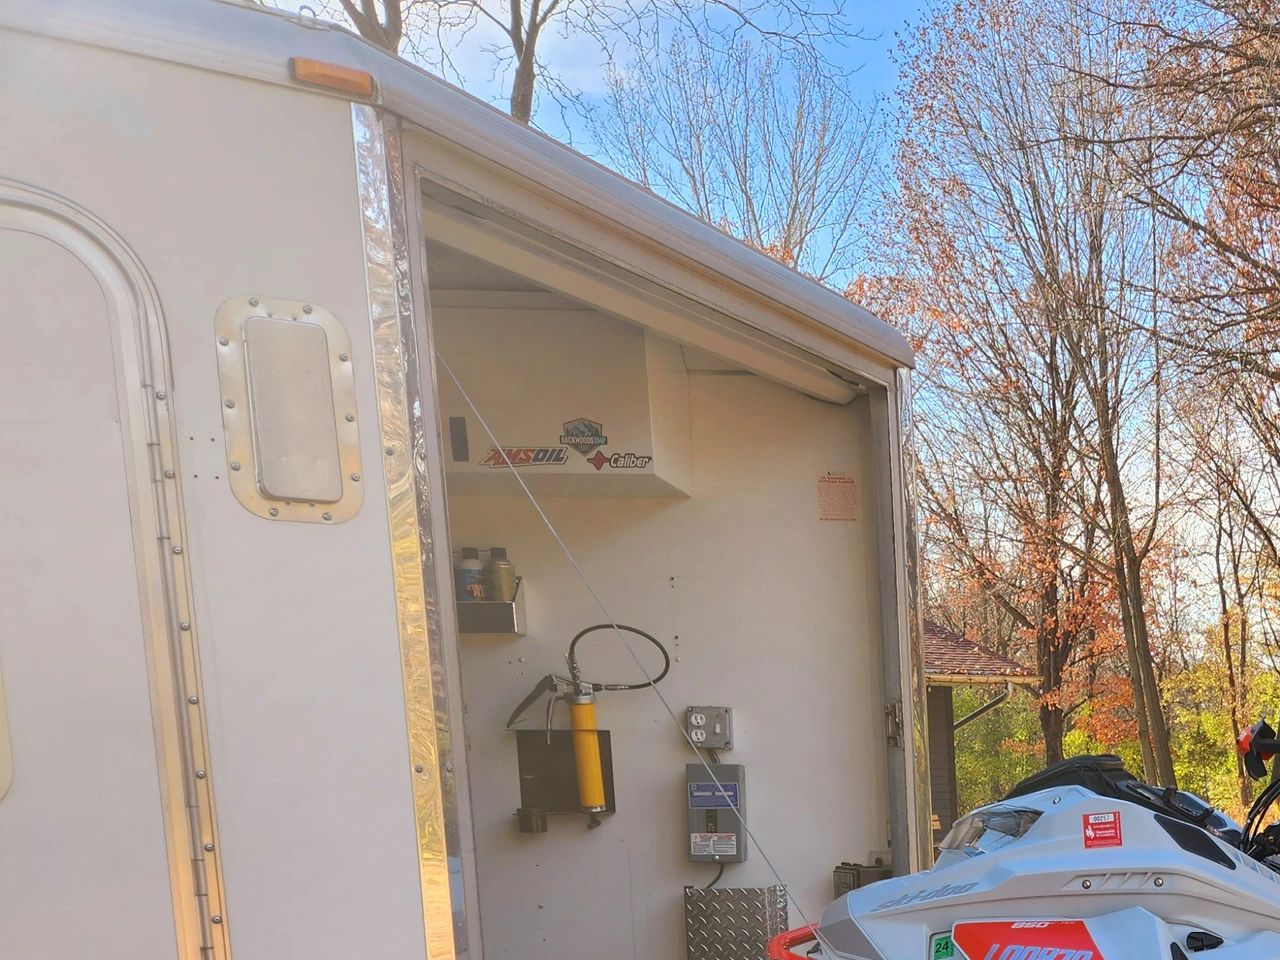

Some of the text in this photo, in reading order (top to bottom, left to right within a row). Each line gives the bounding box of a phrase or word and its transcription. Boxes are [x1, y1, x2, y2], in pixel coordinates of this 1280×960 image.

[484, 448, 567, 465] AMSOIL
[610, 454, 651, 469] Caliber
[934, 940, 950, 954] 24
